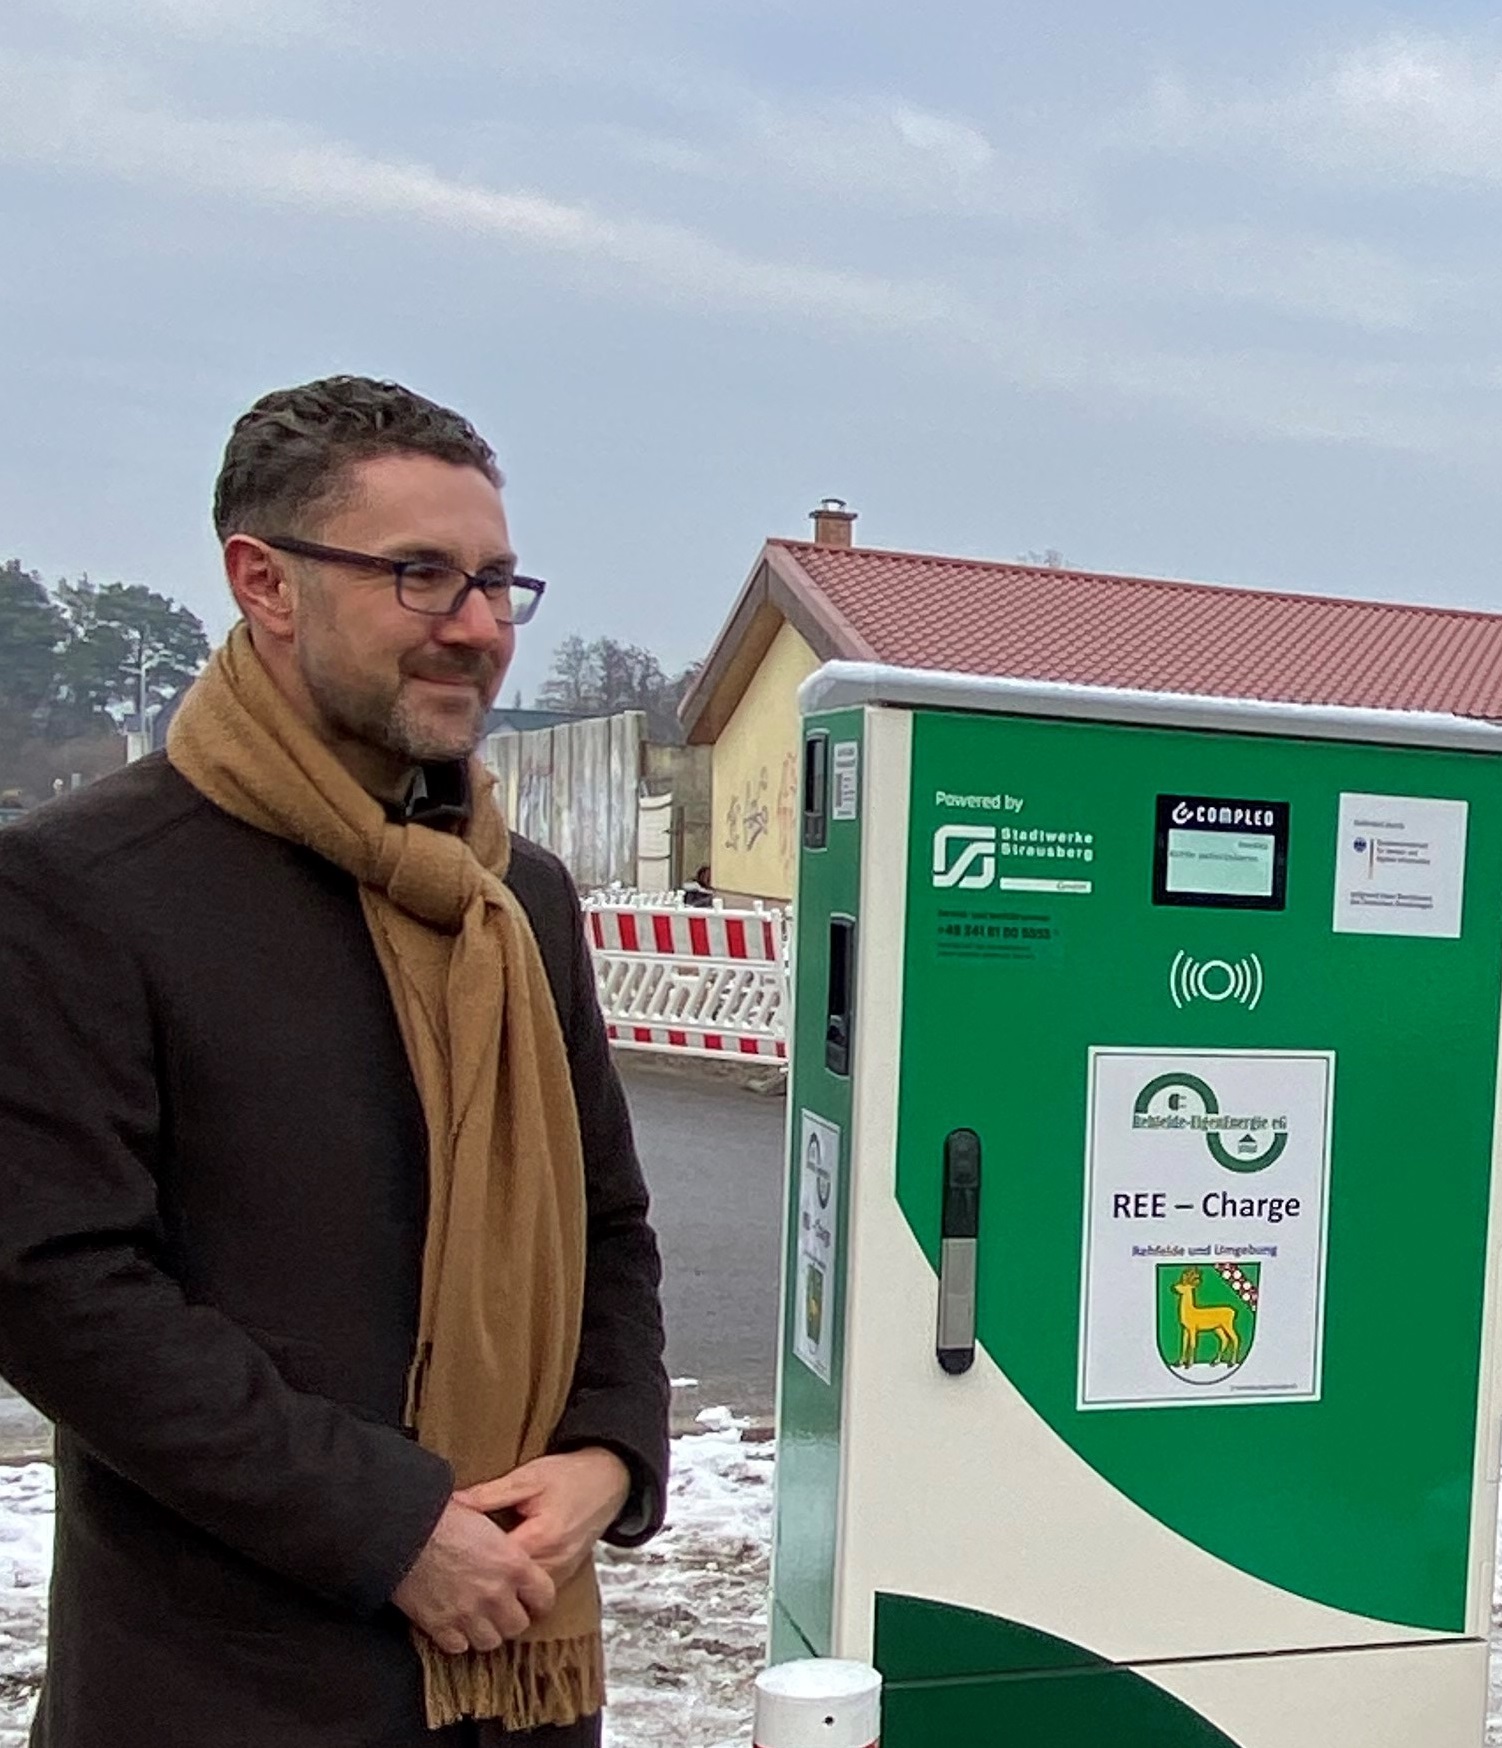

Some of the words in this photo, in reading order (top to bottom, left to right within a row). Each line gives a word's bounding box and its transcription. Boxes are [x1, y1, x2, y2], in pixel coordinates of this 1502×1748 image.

[935, 790, 1001, 810] Powered
[1004, 794, 1024, 813] by
[1196, 806, 1274, 827] COMPLEO
[1001, 827, 1093, 844] Stadtwerke
[1001, 842, 1093, 862] Strausberg
[1113, 1193, 1166, 1218] REE
[1202, 1191, 1300, 1223] Charge
[1188, 1245, 1211, 1256] und
[1214, 1243, 1278, 1258] Umgebung
